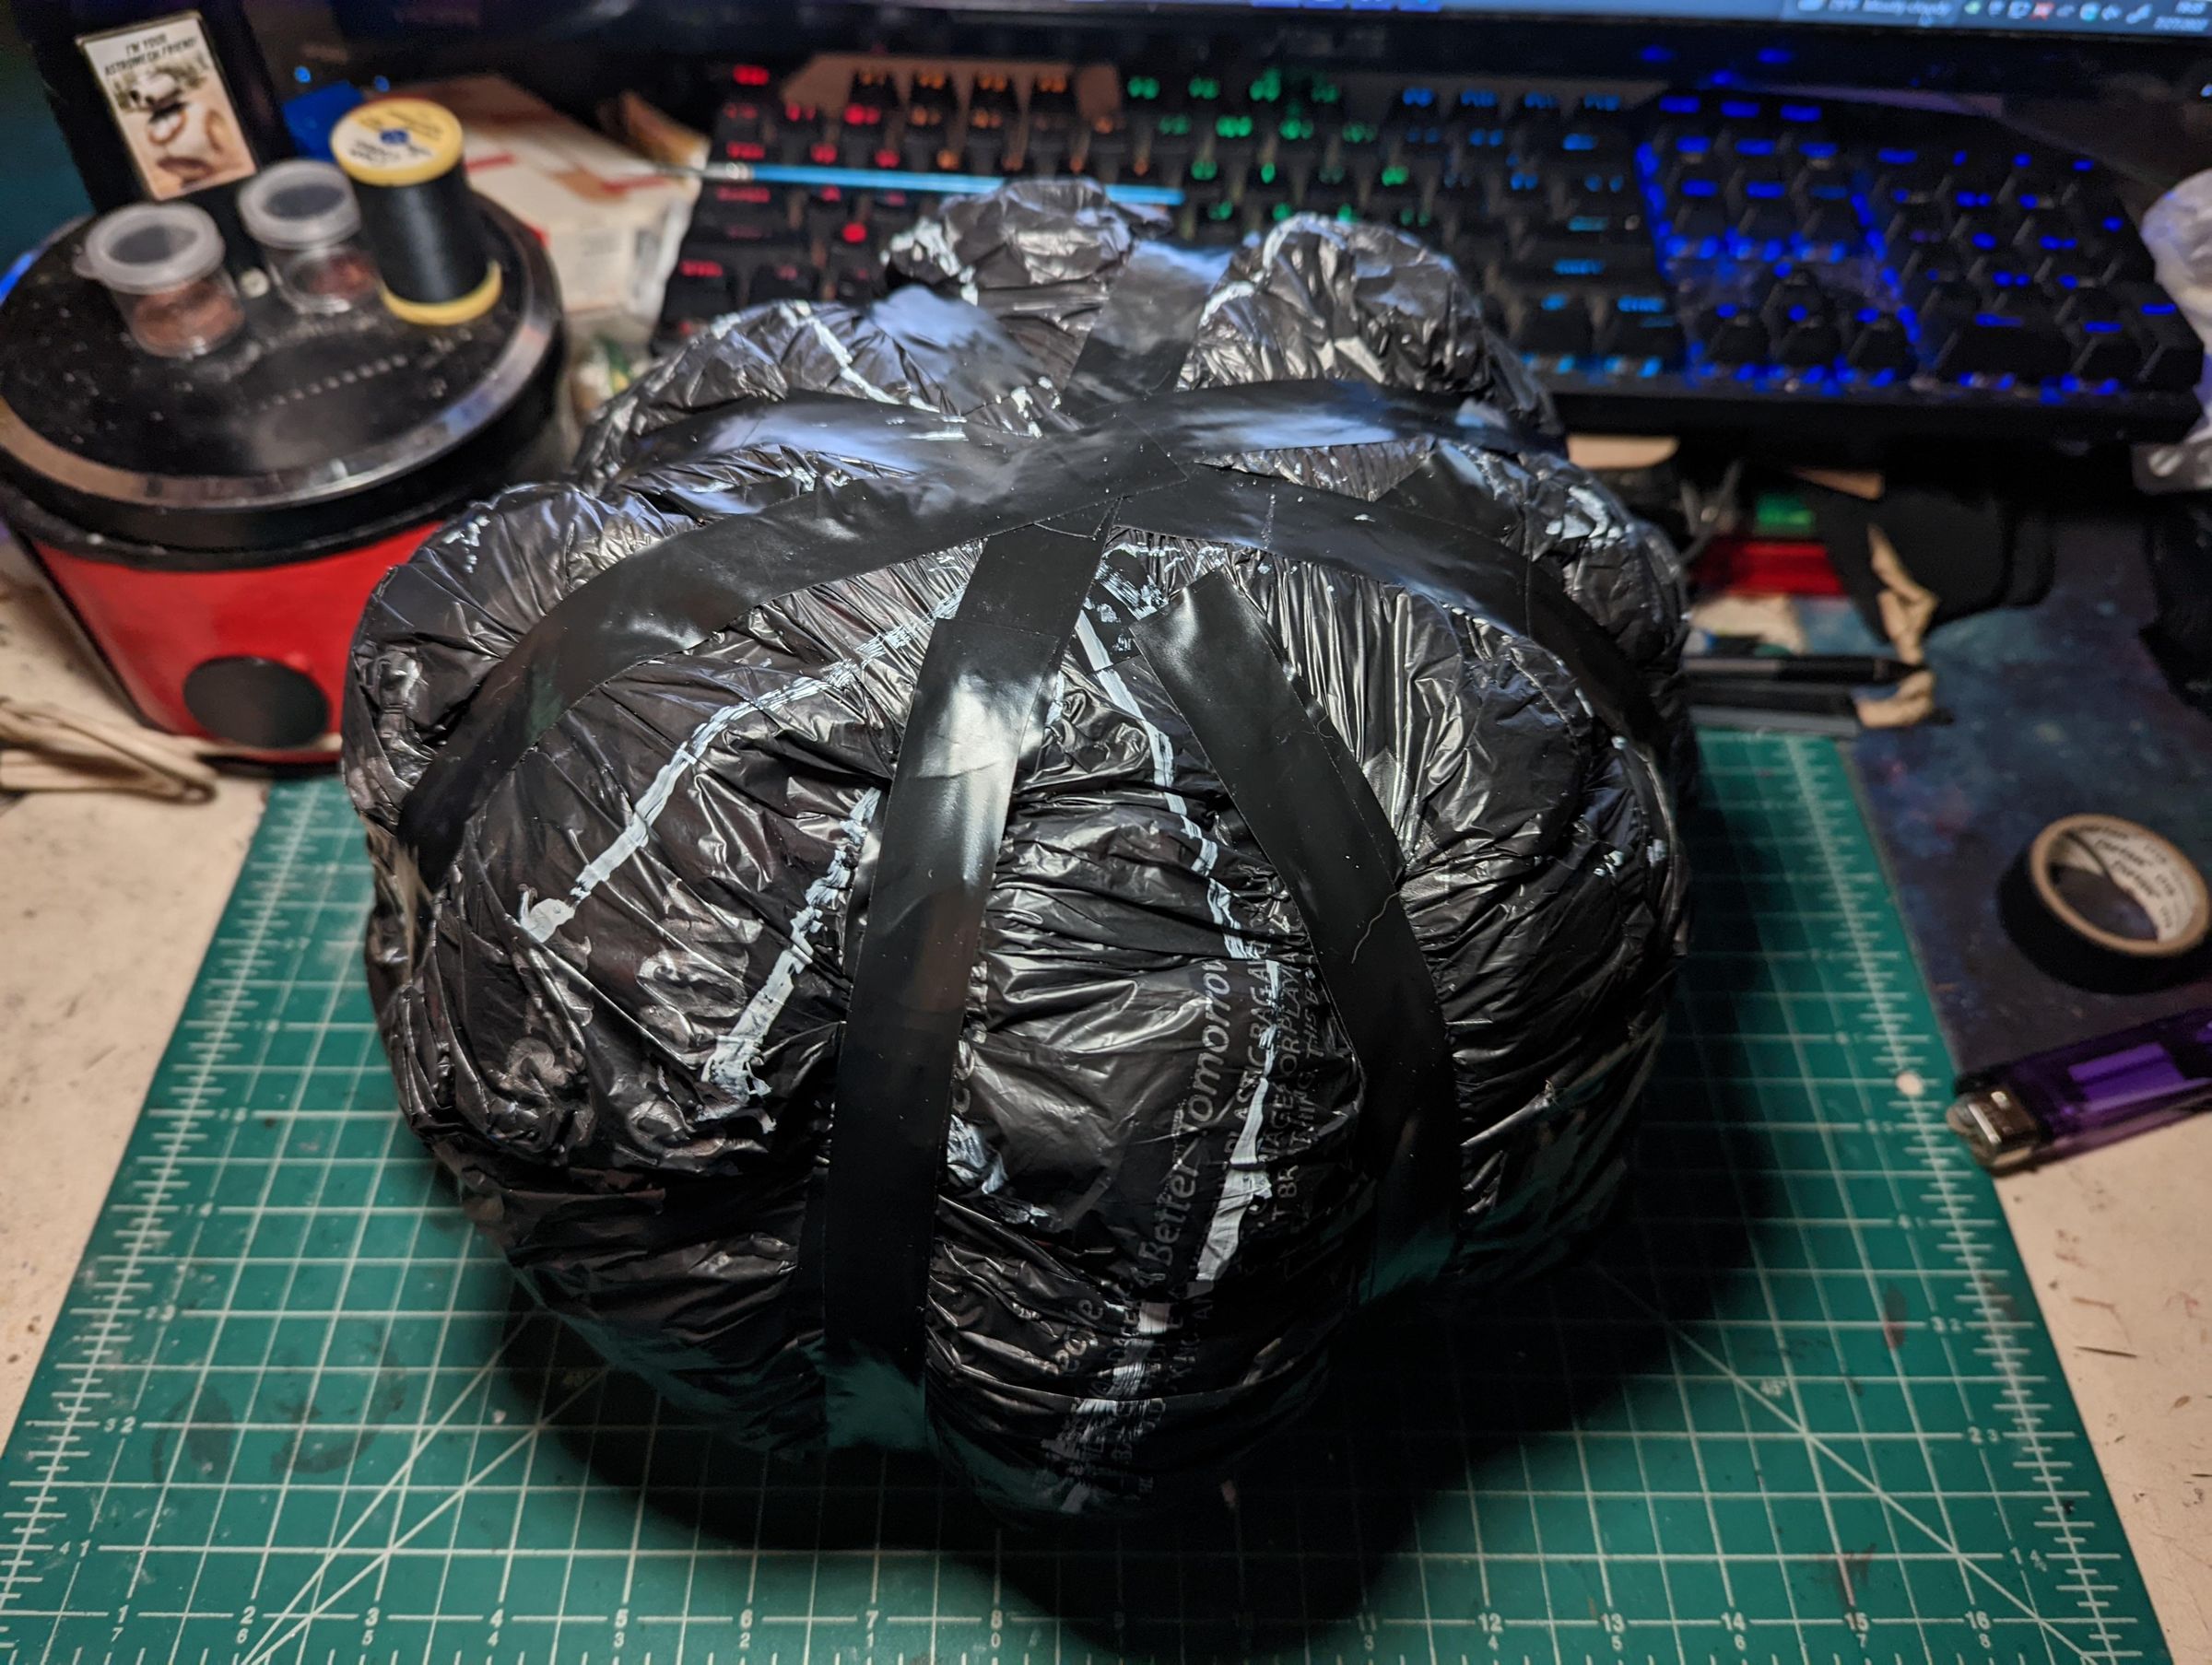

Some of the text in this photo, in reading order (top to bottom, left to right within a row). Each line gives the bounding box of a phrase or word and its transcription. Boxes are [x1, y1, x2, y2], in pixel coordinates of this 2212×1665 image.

[1137, 1159, 1199, 1267] Better
[1931, 1316, 1947, 1333] 3
[121, 1416, 136, 1434] 2
[1969, 1426, 2000, 1444] 2 3
[59, 1541, 91, 1558] 4 1
[2010, 1547, 2042, 1565] 1 4
[118, 1605, 129, 1623] 1
[240, 1606, 257, 1625] 2
[364, 1607, 380, 1626] 3
[489, 1609, 504, 1628] 4
[614, 1609, 629, 1629] 5
[740, 1610, 754, 1629] 6
[865, 1610, 880, 1630] 7
[990, 1609, 1004, 1630] 8
[1477, 1612, 1503, 1634] 12
[1601, 1612, 1627, 1634] 13
[1721, 1612, 1747, 1632] 14
[1844, 1612, 1870, 1632] 15
[1964, 1611, 1992, 1631] 16
[111, 1626, 1992, 1651] 7 6 5 4 3 2 1 0 3 4 5 6 7 8
